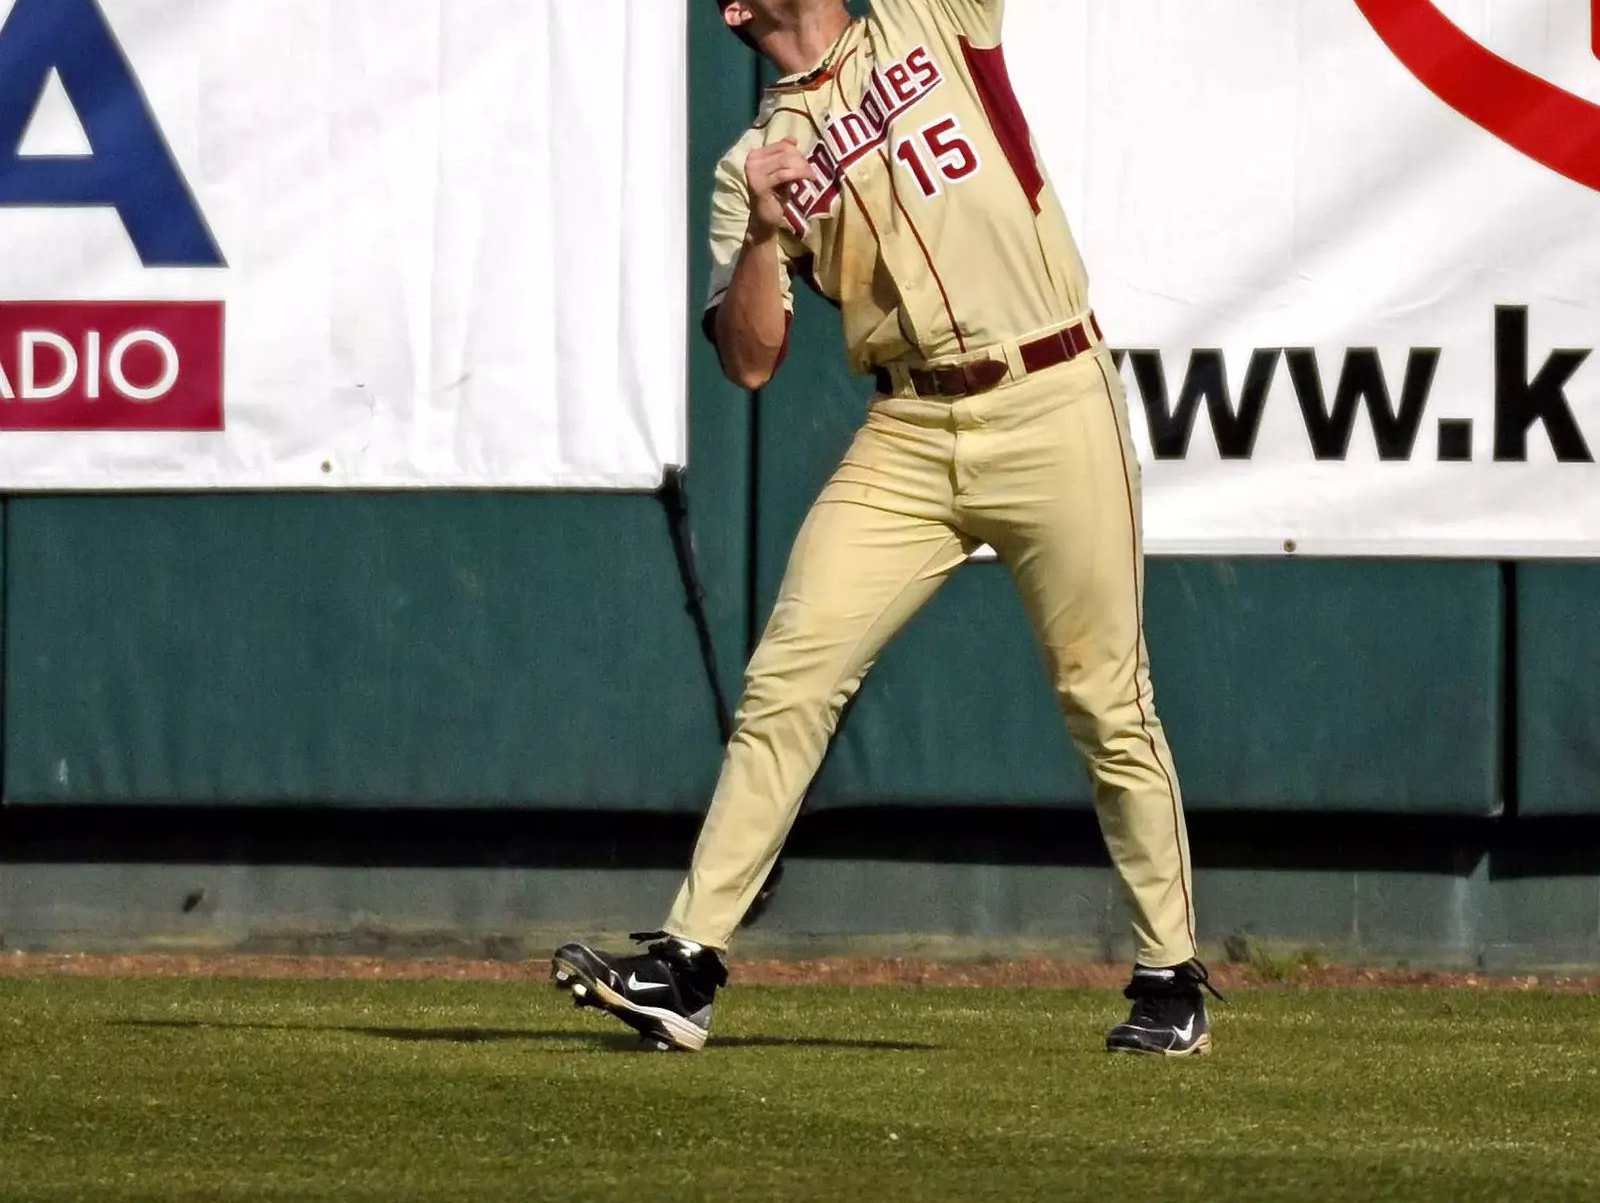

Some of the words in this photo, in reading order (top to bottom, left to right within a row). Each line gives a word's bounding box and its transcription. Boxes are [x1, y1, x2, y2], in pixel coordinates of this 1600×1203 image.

[784, 45, 944, 240] eminoles
[895, 115, 982, 200] 15
[0, 330, 179, 400] DIO
[1109, 304, 1595, 463] ww.k
